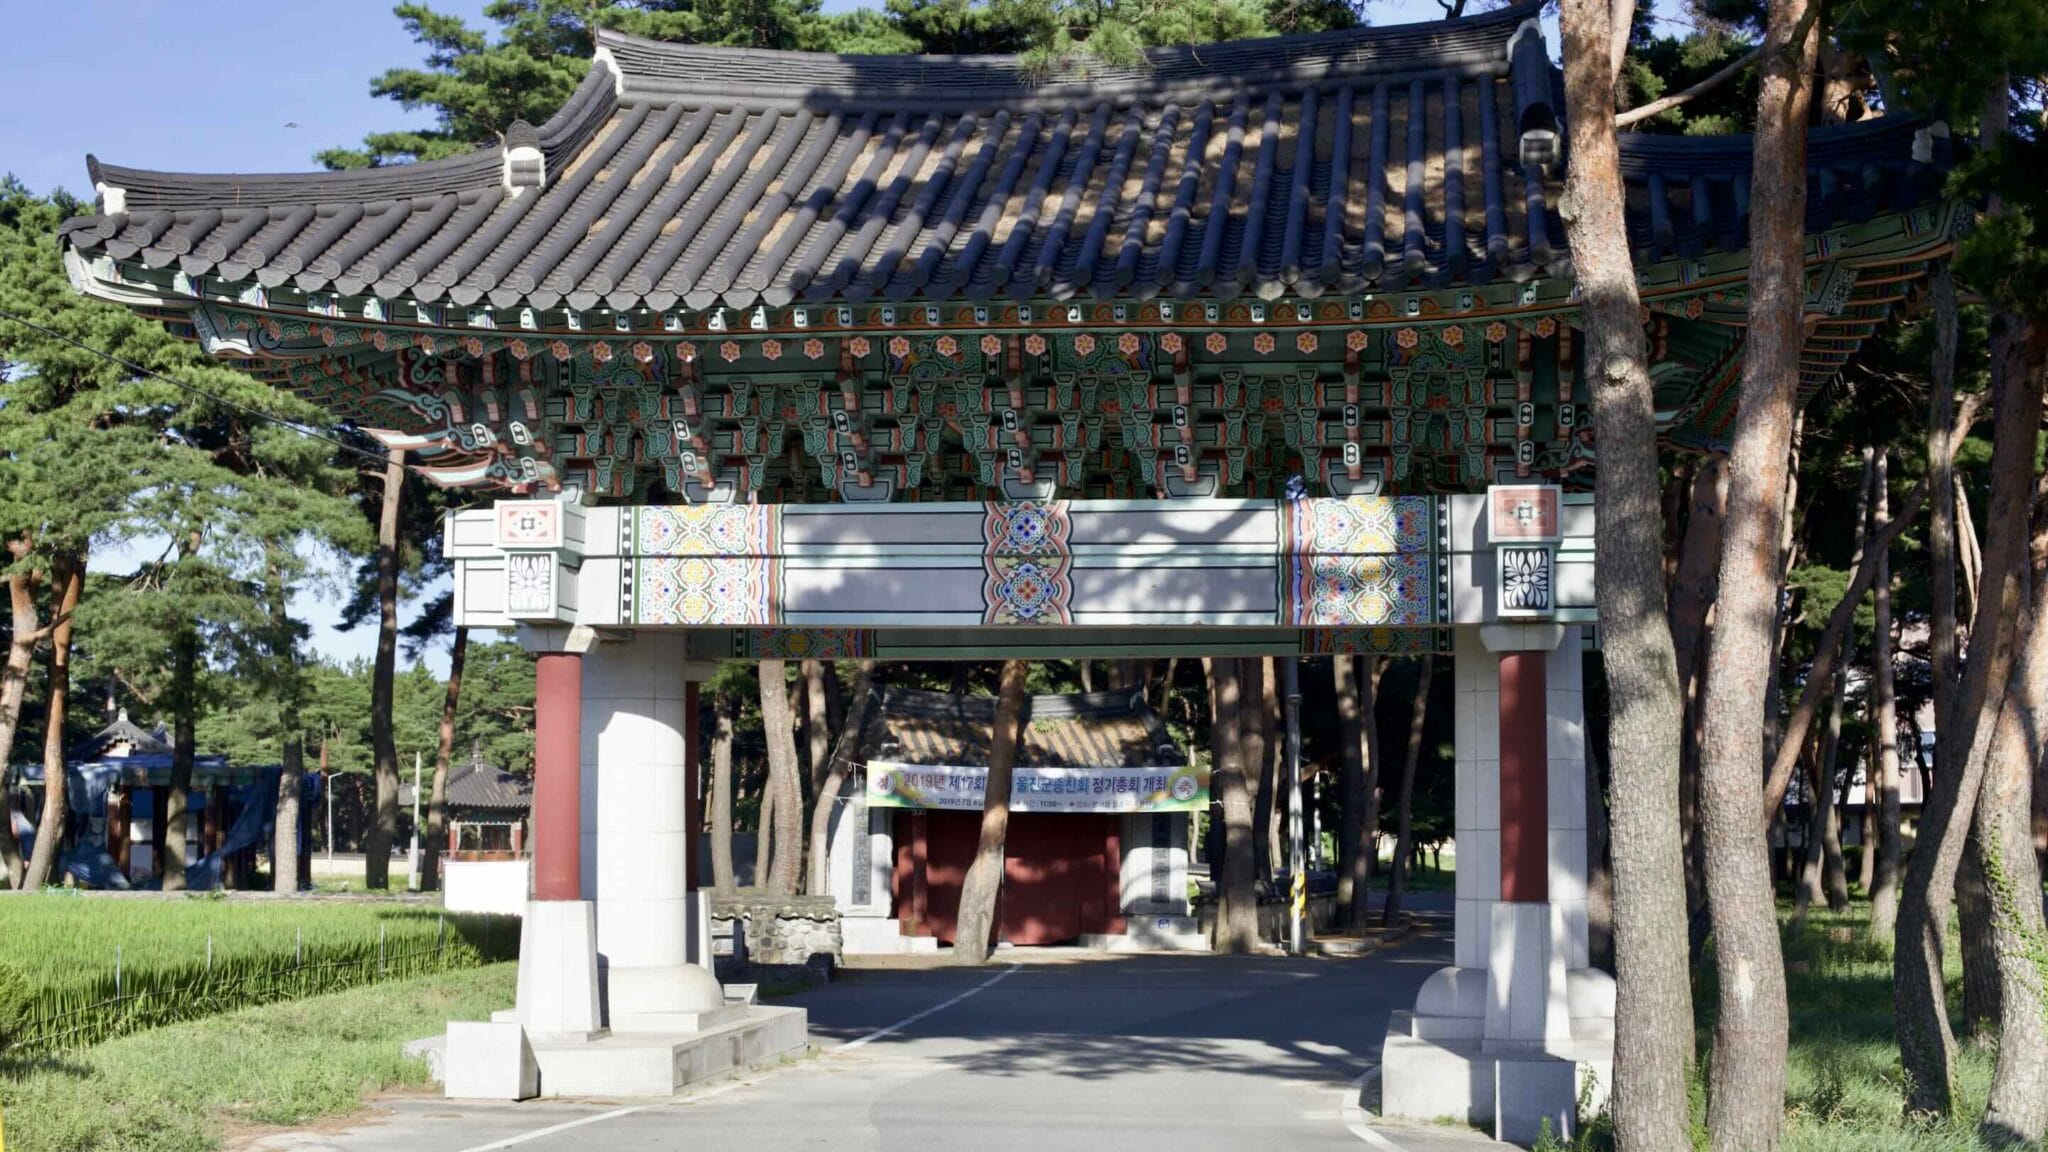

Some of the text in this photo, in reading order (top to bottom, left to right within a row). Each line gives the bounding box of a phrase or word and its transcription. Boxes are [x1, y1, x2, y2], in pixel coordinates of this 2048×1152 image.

[903, 773, 945, 791] 2019년
[949, 775, 985, 792] 제17회
[1092, 776, 1140, 794] 정기총회
[1143, 776, 1167, 793] 개최
[1177, 780, 1193, 795] 축
